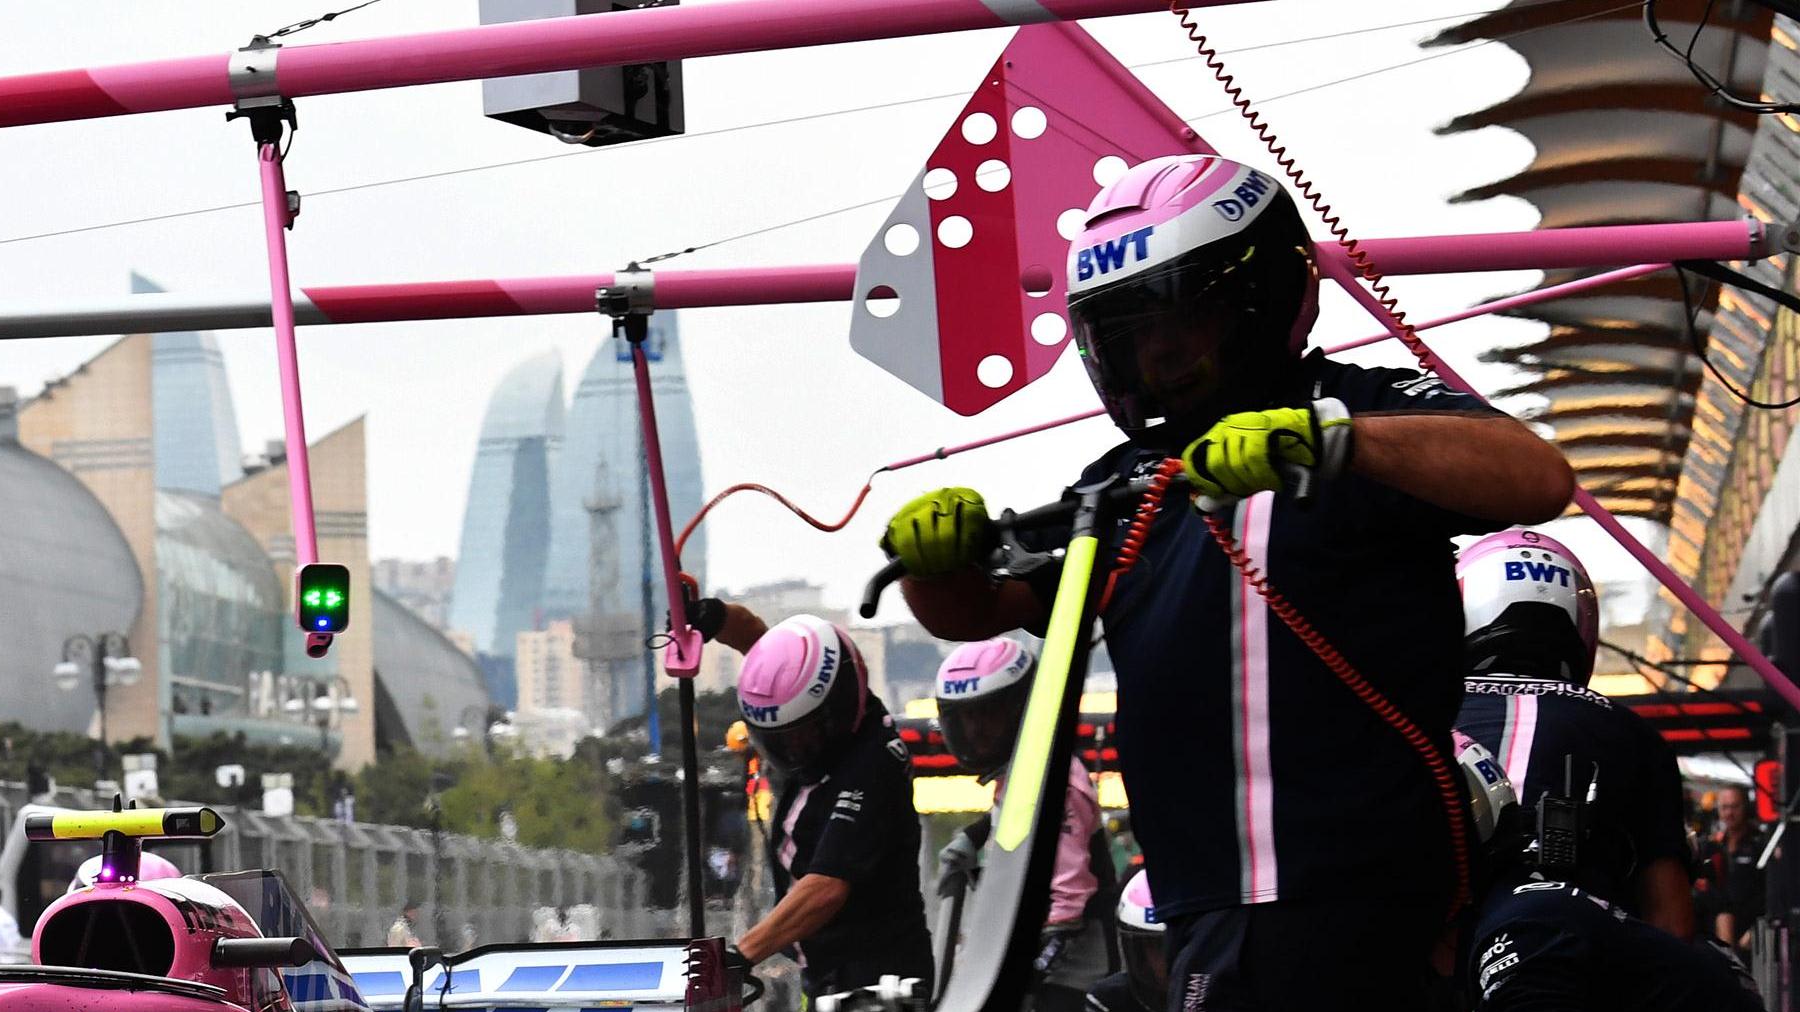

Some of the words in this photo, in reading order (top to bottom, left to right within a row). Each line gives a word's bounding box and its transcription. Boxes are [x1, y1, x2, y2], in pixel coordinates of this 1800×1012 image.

[1077, 225, 1154, 282] BWT
[1505, 561, 1570, 588] BWT
[818, 646, 837, 683] BWT
[944, 677, 980, 694] BWT
